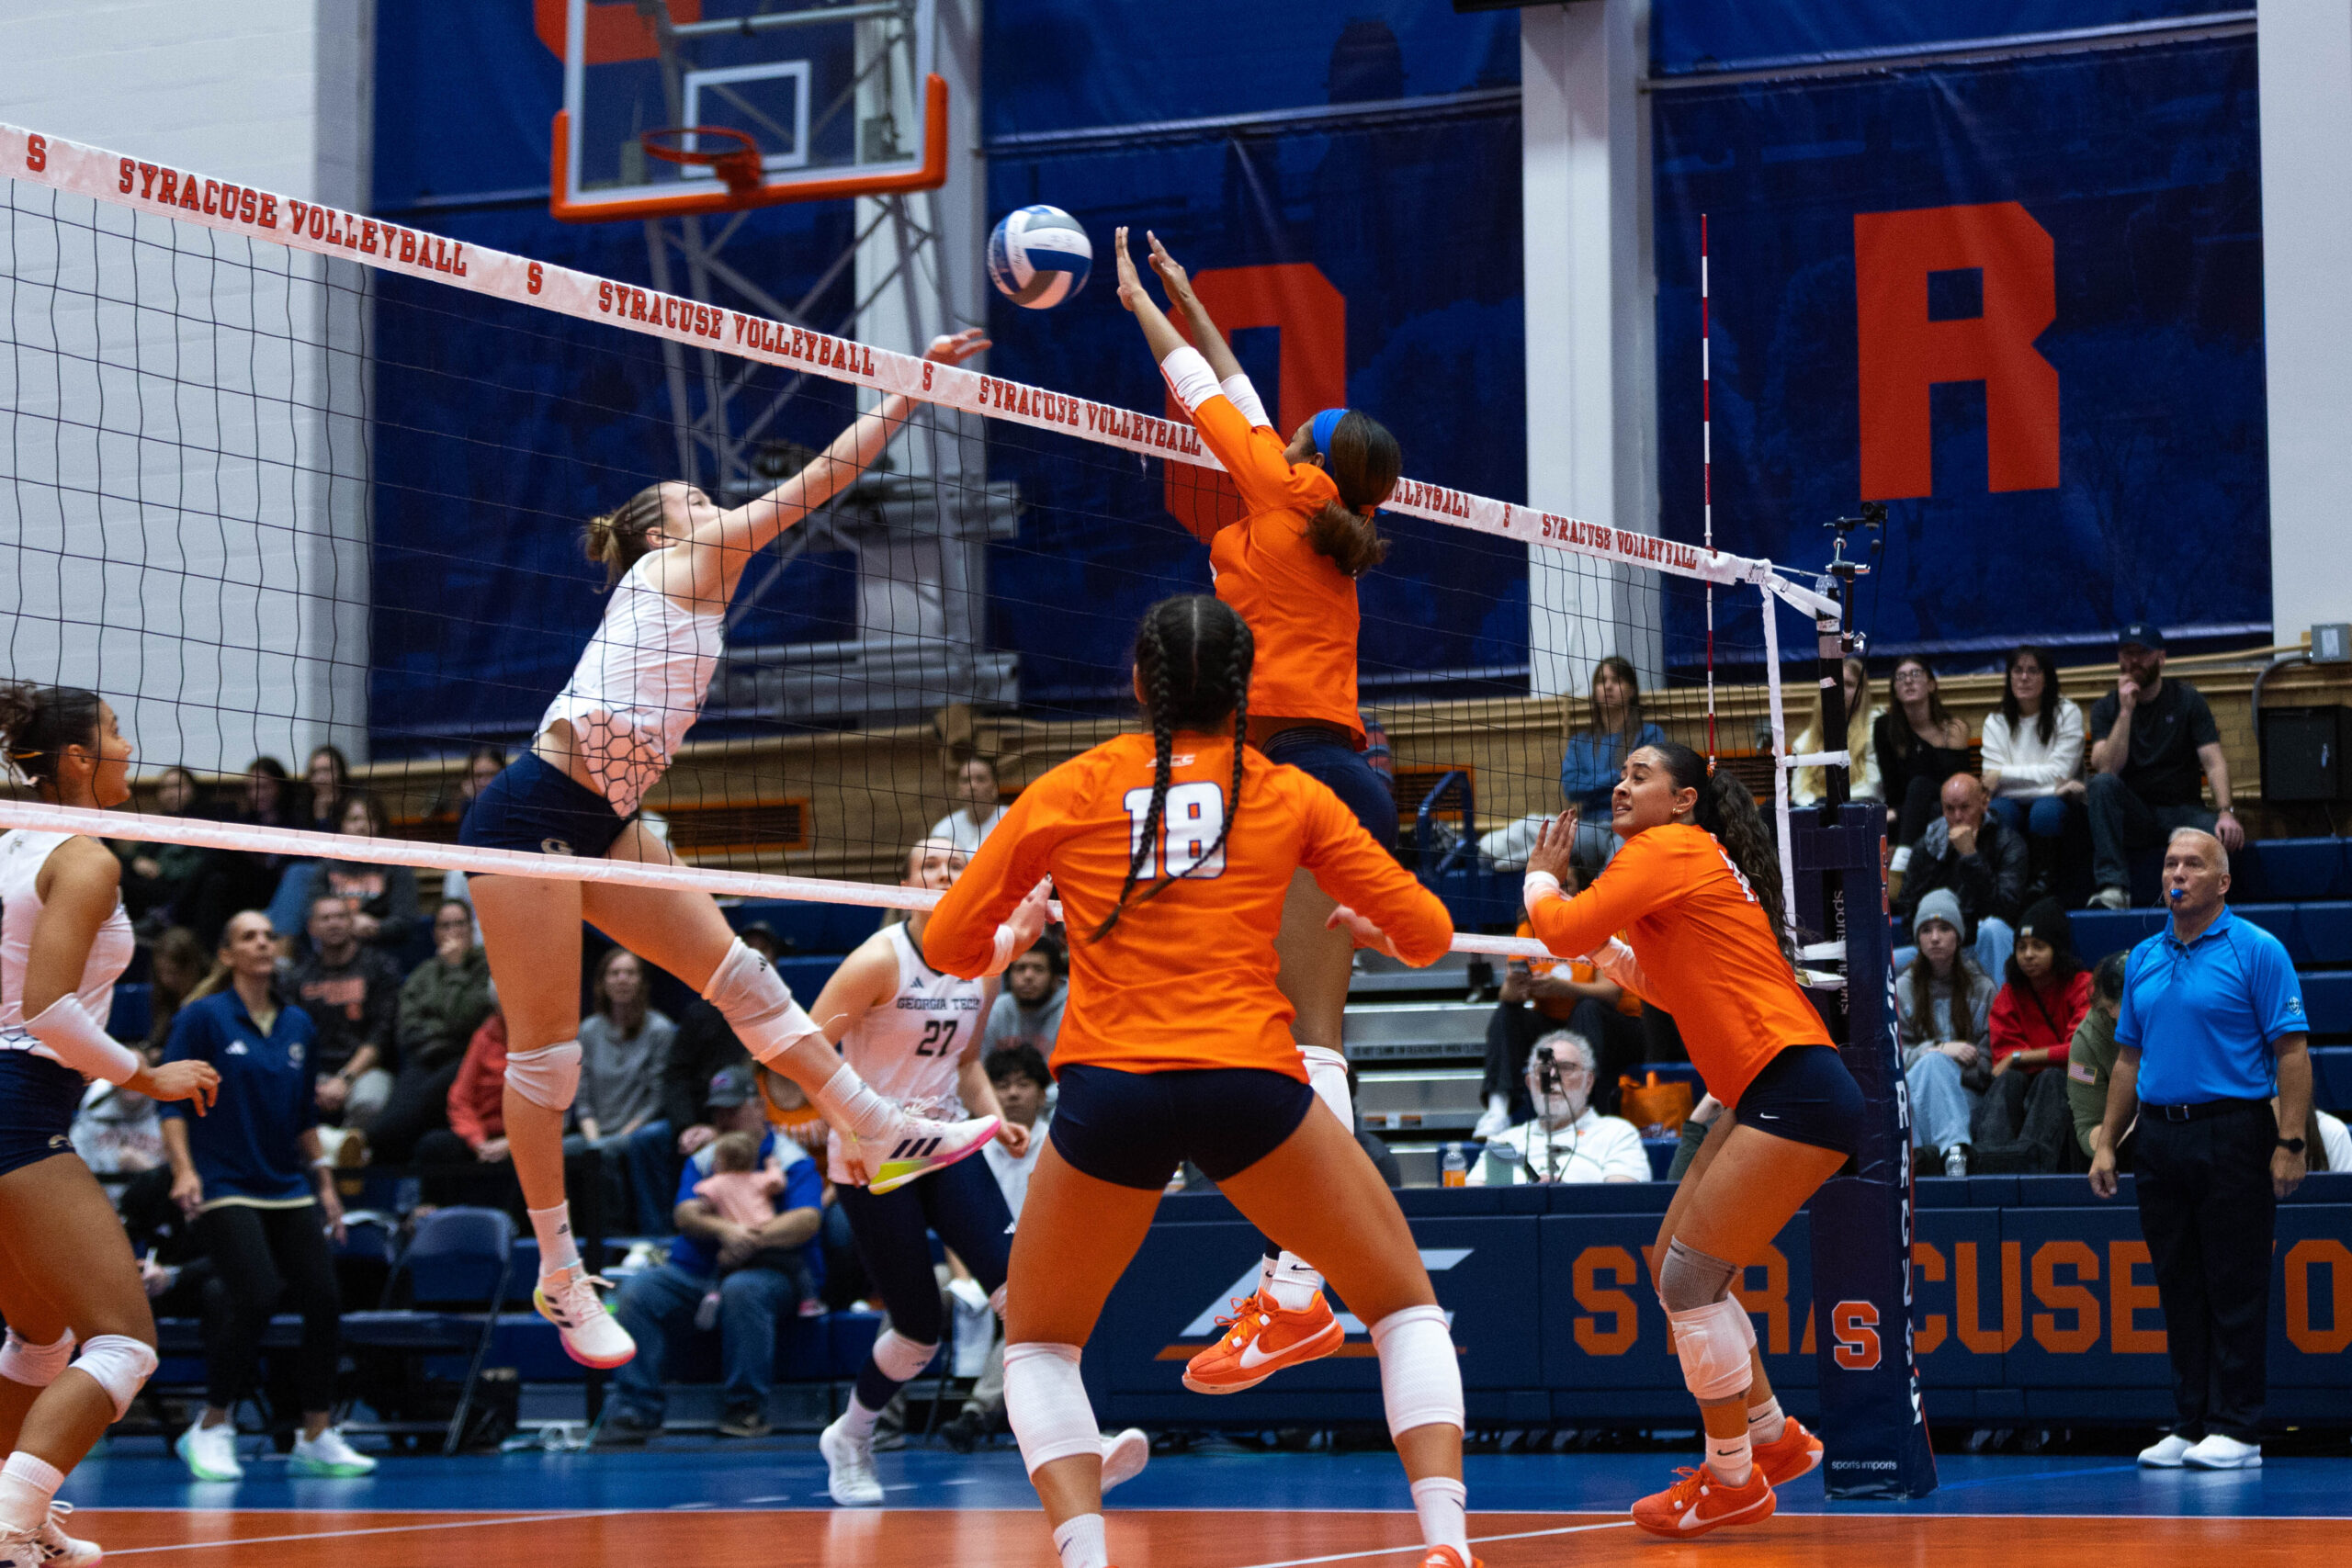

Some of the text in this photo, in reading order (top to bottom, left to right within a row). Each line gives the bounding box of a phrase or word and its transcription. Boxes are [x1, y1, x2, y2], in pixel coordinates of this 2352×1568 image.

[27, 134, 47, 173] S
[119, 157, 468, 277] SYRACUSE VOLLEYBALL
[526, 262, 544, 296] S
[599, 280, 875, 376] SYRACUSE VOLLEYBALL
[1854, 201, 2060, 502] R
[922, 361, 933, 391] S
[978, 375, 1202, 457] SYRACUSE VOLLEYBALL
[1386, 478, 1470, 518] LLEYBALL
[1503, 503, 1511, 528] S
[1542, 513, 1698, 570] SYRACUSE VOLLEYBALL
[1123, 781, 1227, 881] 18
[896, 998, 980, 1010] GEORGIA TECH
[916, 1020, 958, 1057] 27
[1572, 1240, 2168, 1357] SRCUSE
[1831, 1300, 1883, 1371] S
[1831, 1460, 1897, 1472] sports imports
